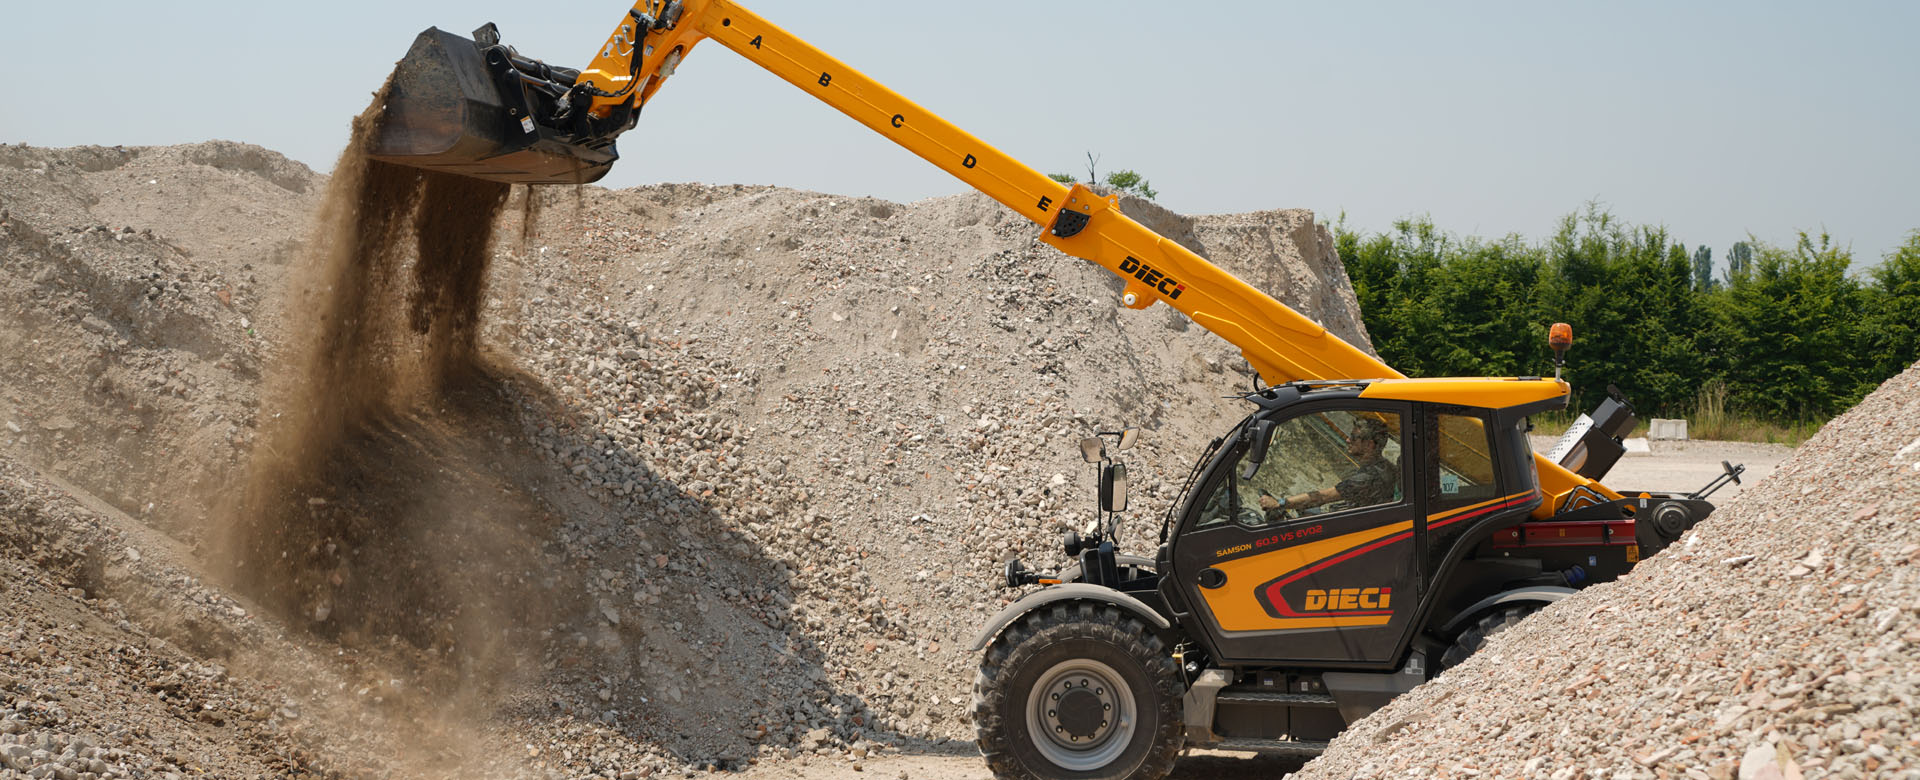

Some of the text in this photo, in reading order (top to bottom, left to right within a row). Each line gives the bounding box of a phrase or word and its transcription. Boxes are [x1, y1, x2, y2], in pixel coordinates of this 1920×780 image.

[749, 35, 763, 49] A
[818, 72, 832, 87] B
[891, 114, 904, 128] C
[962, 154, 977, 169] D
[1037, 195, 1052, 212] E
[1216, 544, 1252, 557] SAMSON
[1255, 536, 1279, 547] 60.9
[1280, 532, 1294, 541] VS
